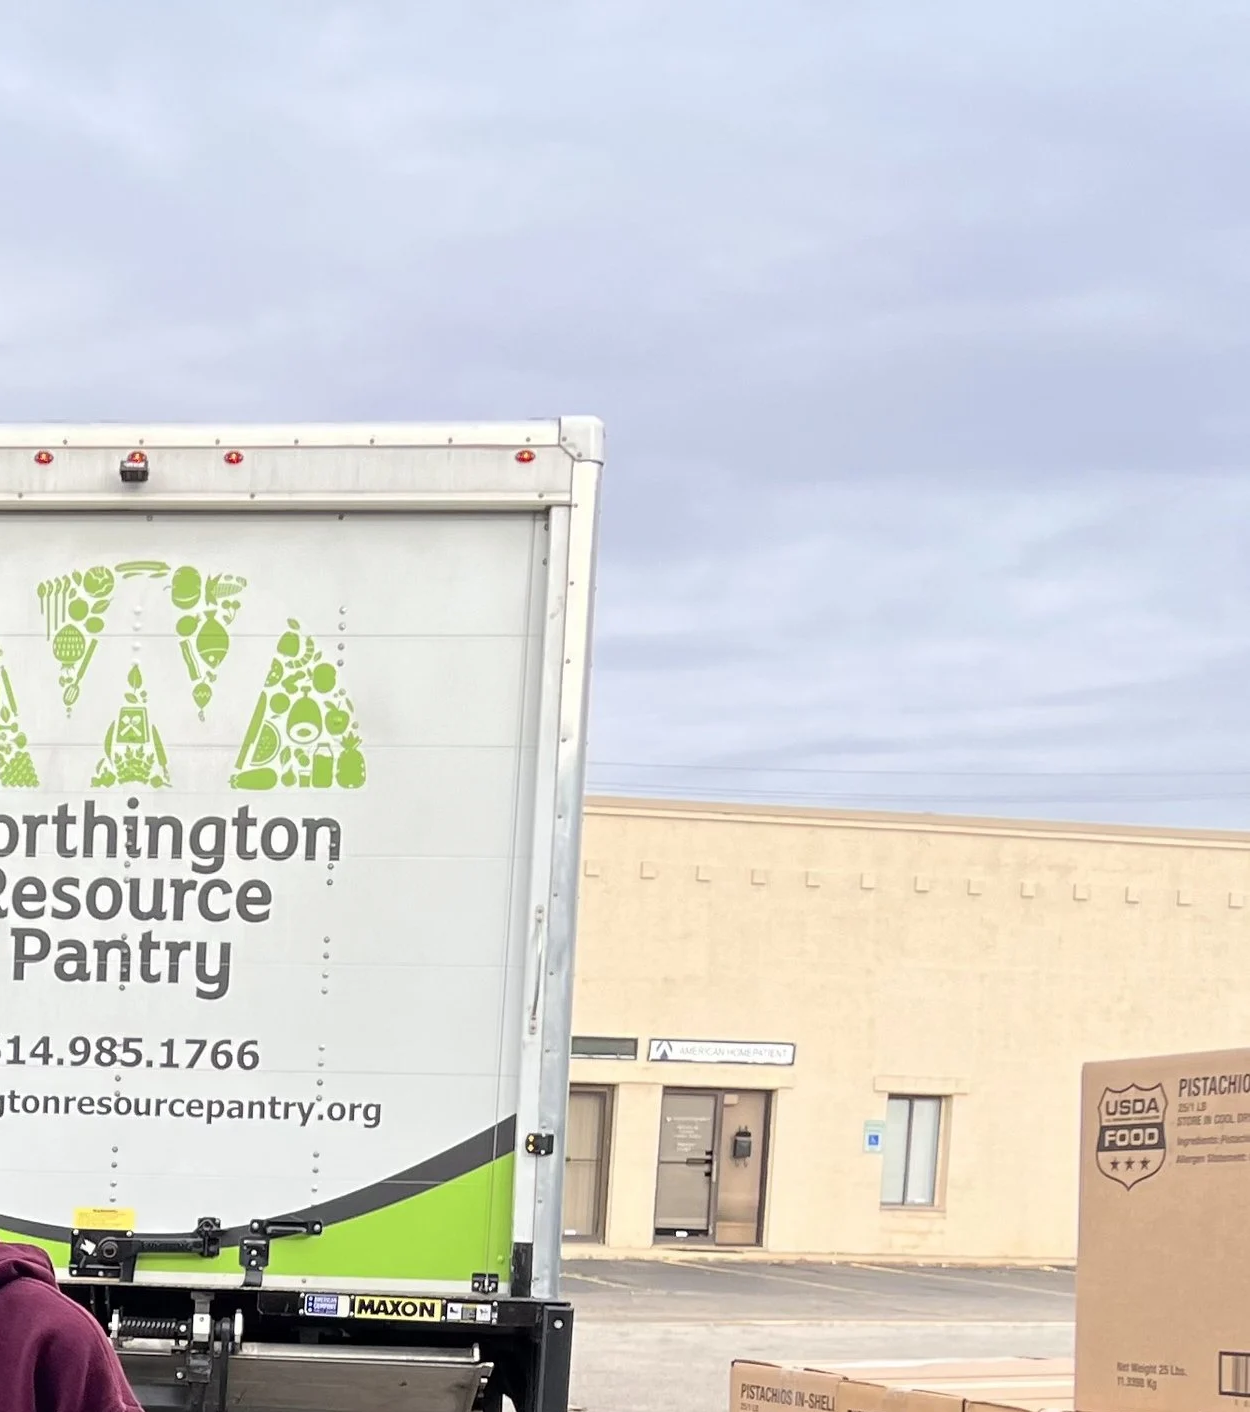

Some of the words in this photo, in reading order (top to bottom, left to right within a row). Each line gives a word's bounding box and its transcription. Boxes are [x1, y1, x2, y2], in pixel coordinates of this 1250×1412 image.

[11, 928, 232, 1000] Pantry
[679, 1046, 724, 1057] AMERICAN
[1105, 1097, 1160, 1116] USDA
[1104, 1127, 1160, 1147] FOOD
[357, 1298, 436, 1318] MAXON
[740, 1383, 794, 1406] PISTACHIOS
